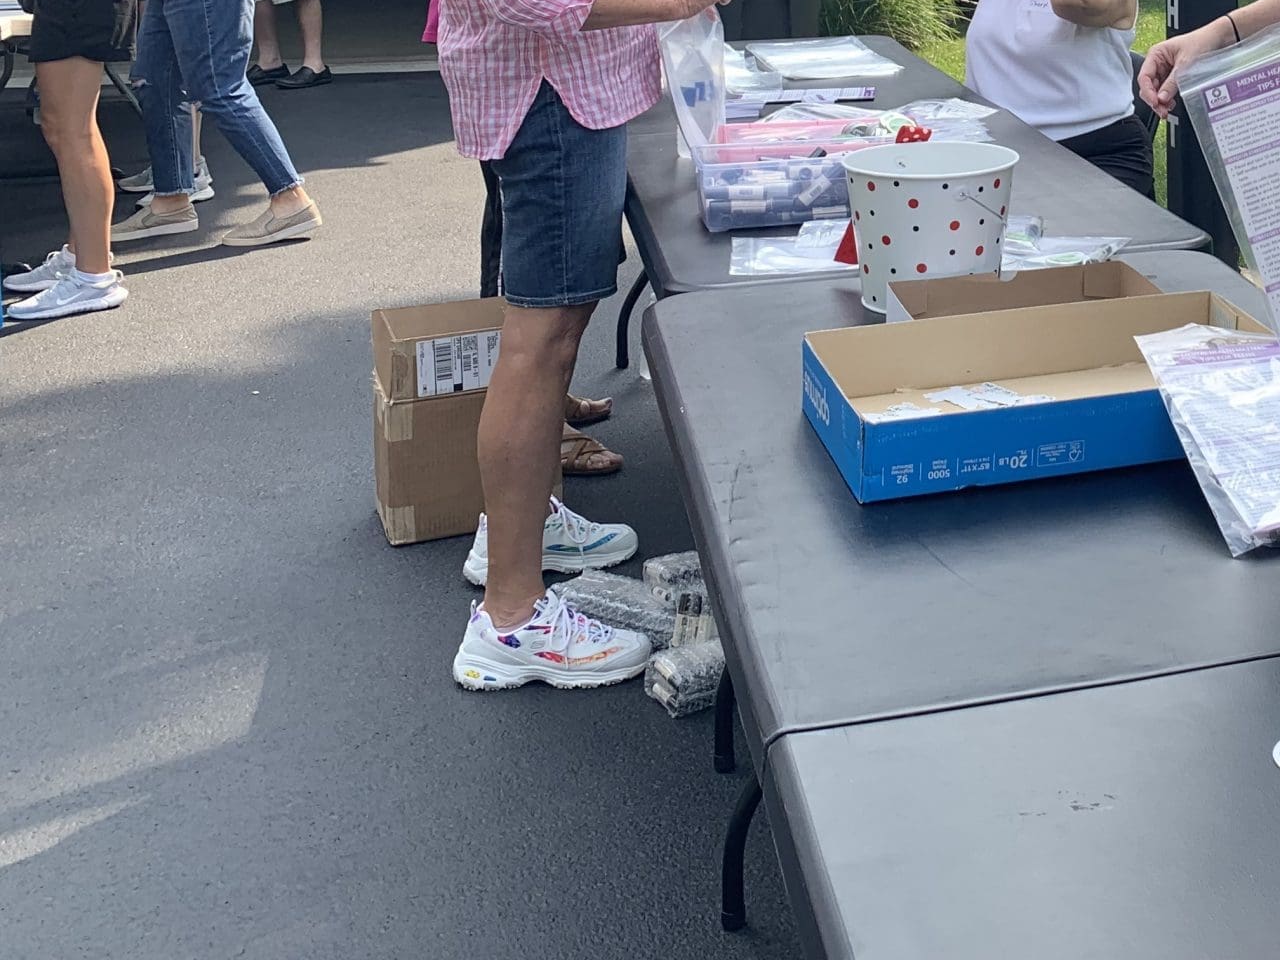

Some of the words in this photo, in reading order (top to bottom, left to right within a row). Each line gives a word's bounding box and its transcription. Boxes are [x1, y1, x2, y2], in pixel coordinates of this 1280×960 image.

[1236, 72, 1266, 88] MENTAL
[1257, 80, 1275, 92] TIPS
[1010, 454, 1027, 469] 20
[896, 474, 908, 484] 92
[928, 469, 951, 480] 5000
